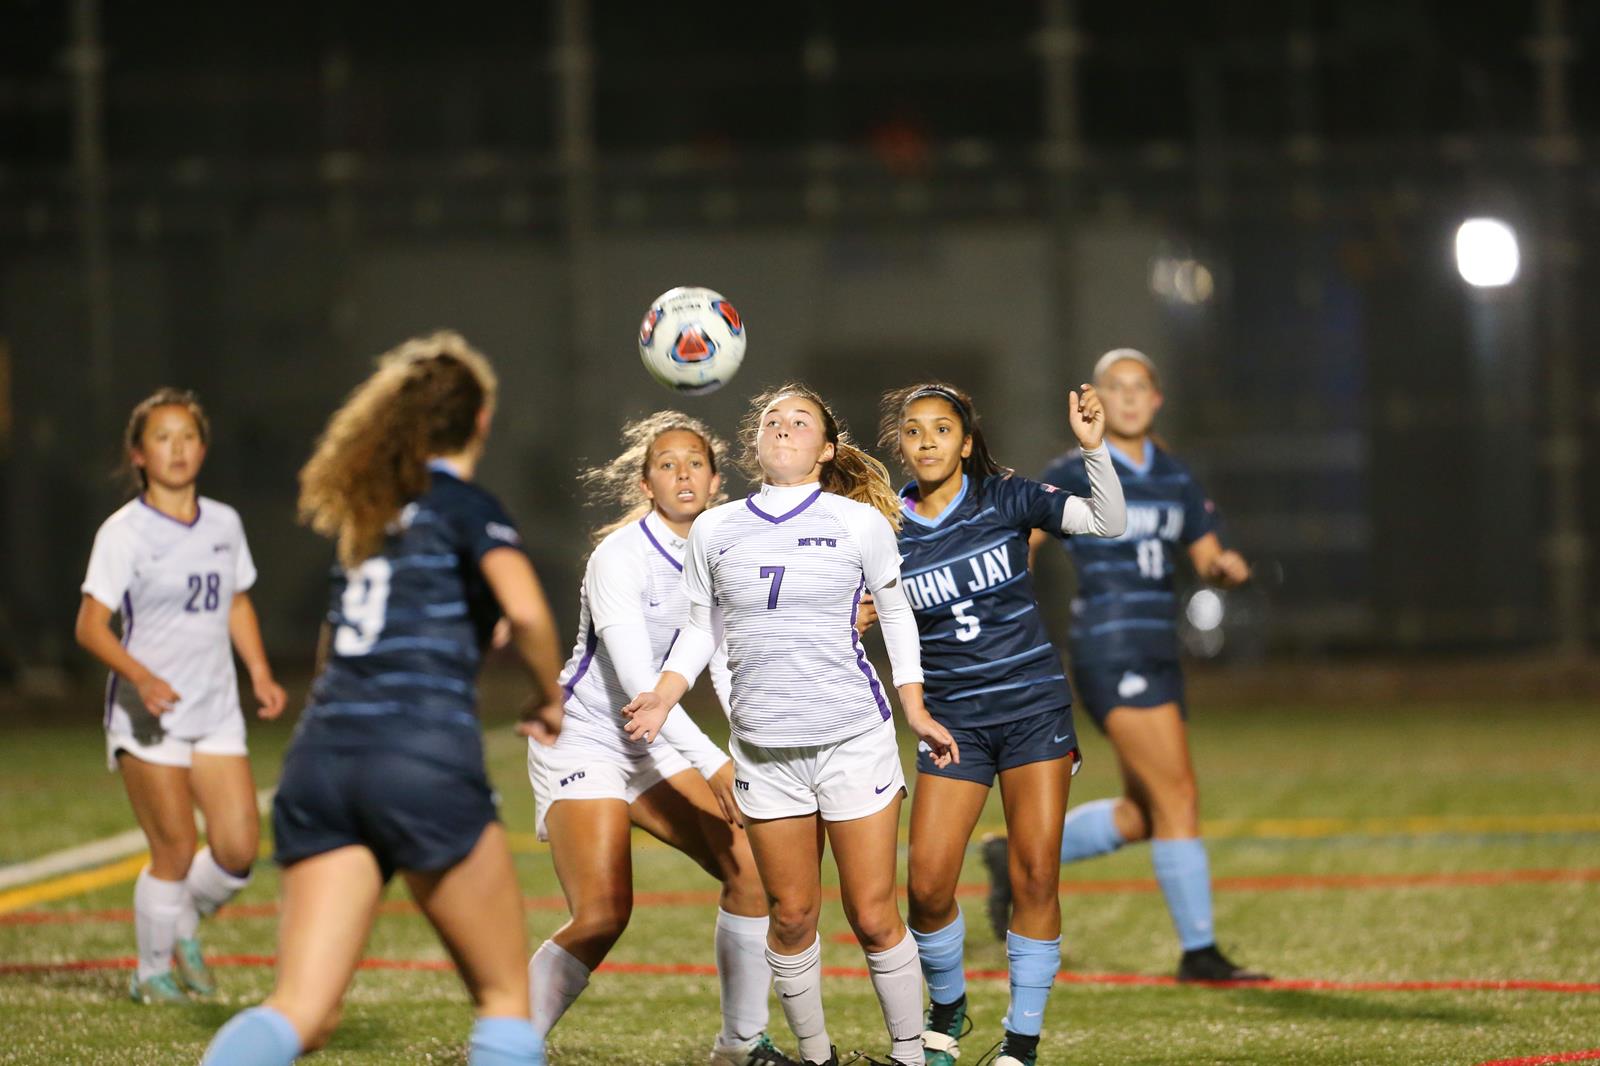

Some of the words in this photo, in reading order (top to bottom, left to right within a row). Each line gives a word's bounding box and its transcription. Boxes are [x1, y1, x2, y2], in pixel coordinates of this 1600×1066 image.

[798, 537, 836, 548] NYU
[184, 573, 221, 613] 28
[760, 566, 785, 609] 7
[902, 566, 960, 611] OHN
[967, 543, 1013, 592] JAY
[334, 556, 392, 656] 9
[951, 600, 981, 642] 5
[560, 771, 585, 787] NYU
